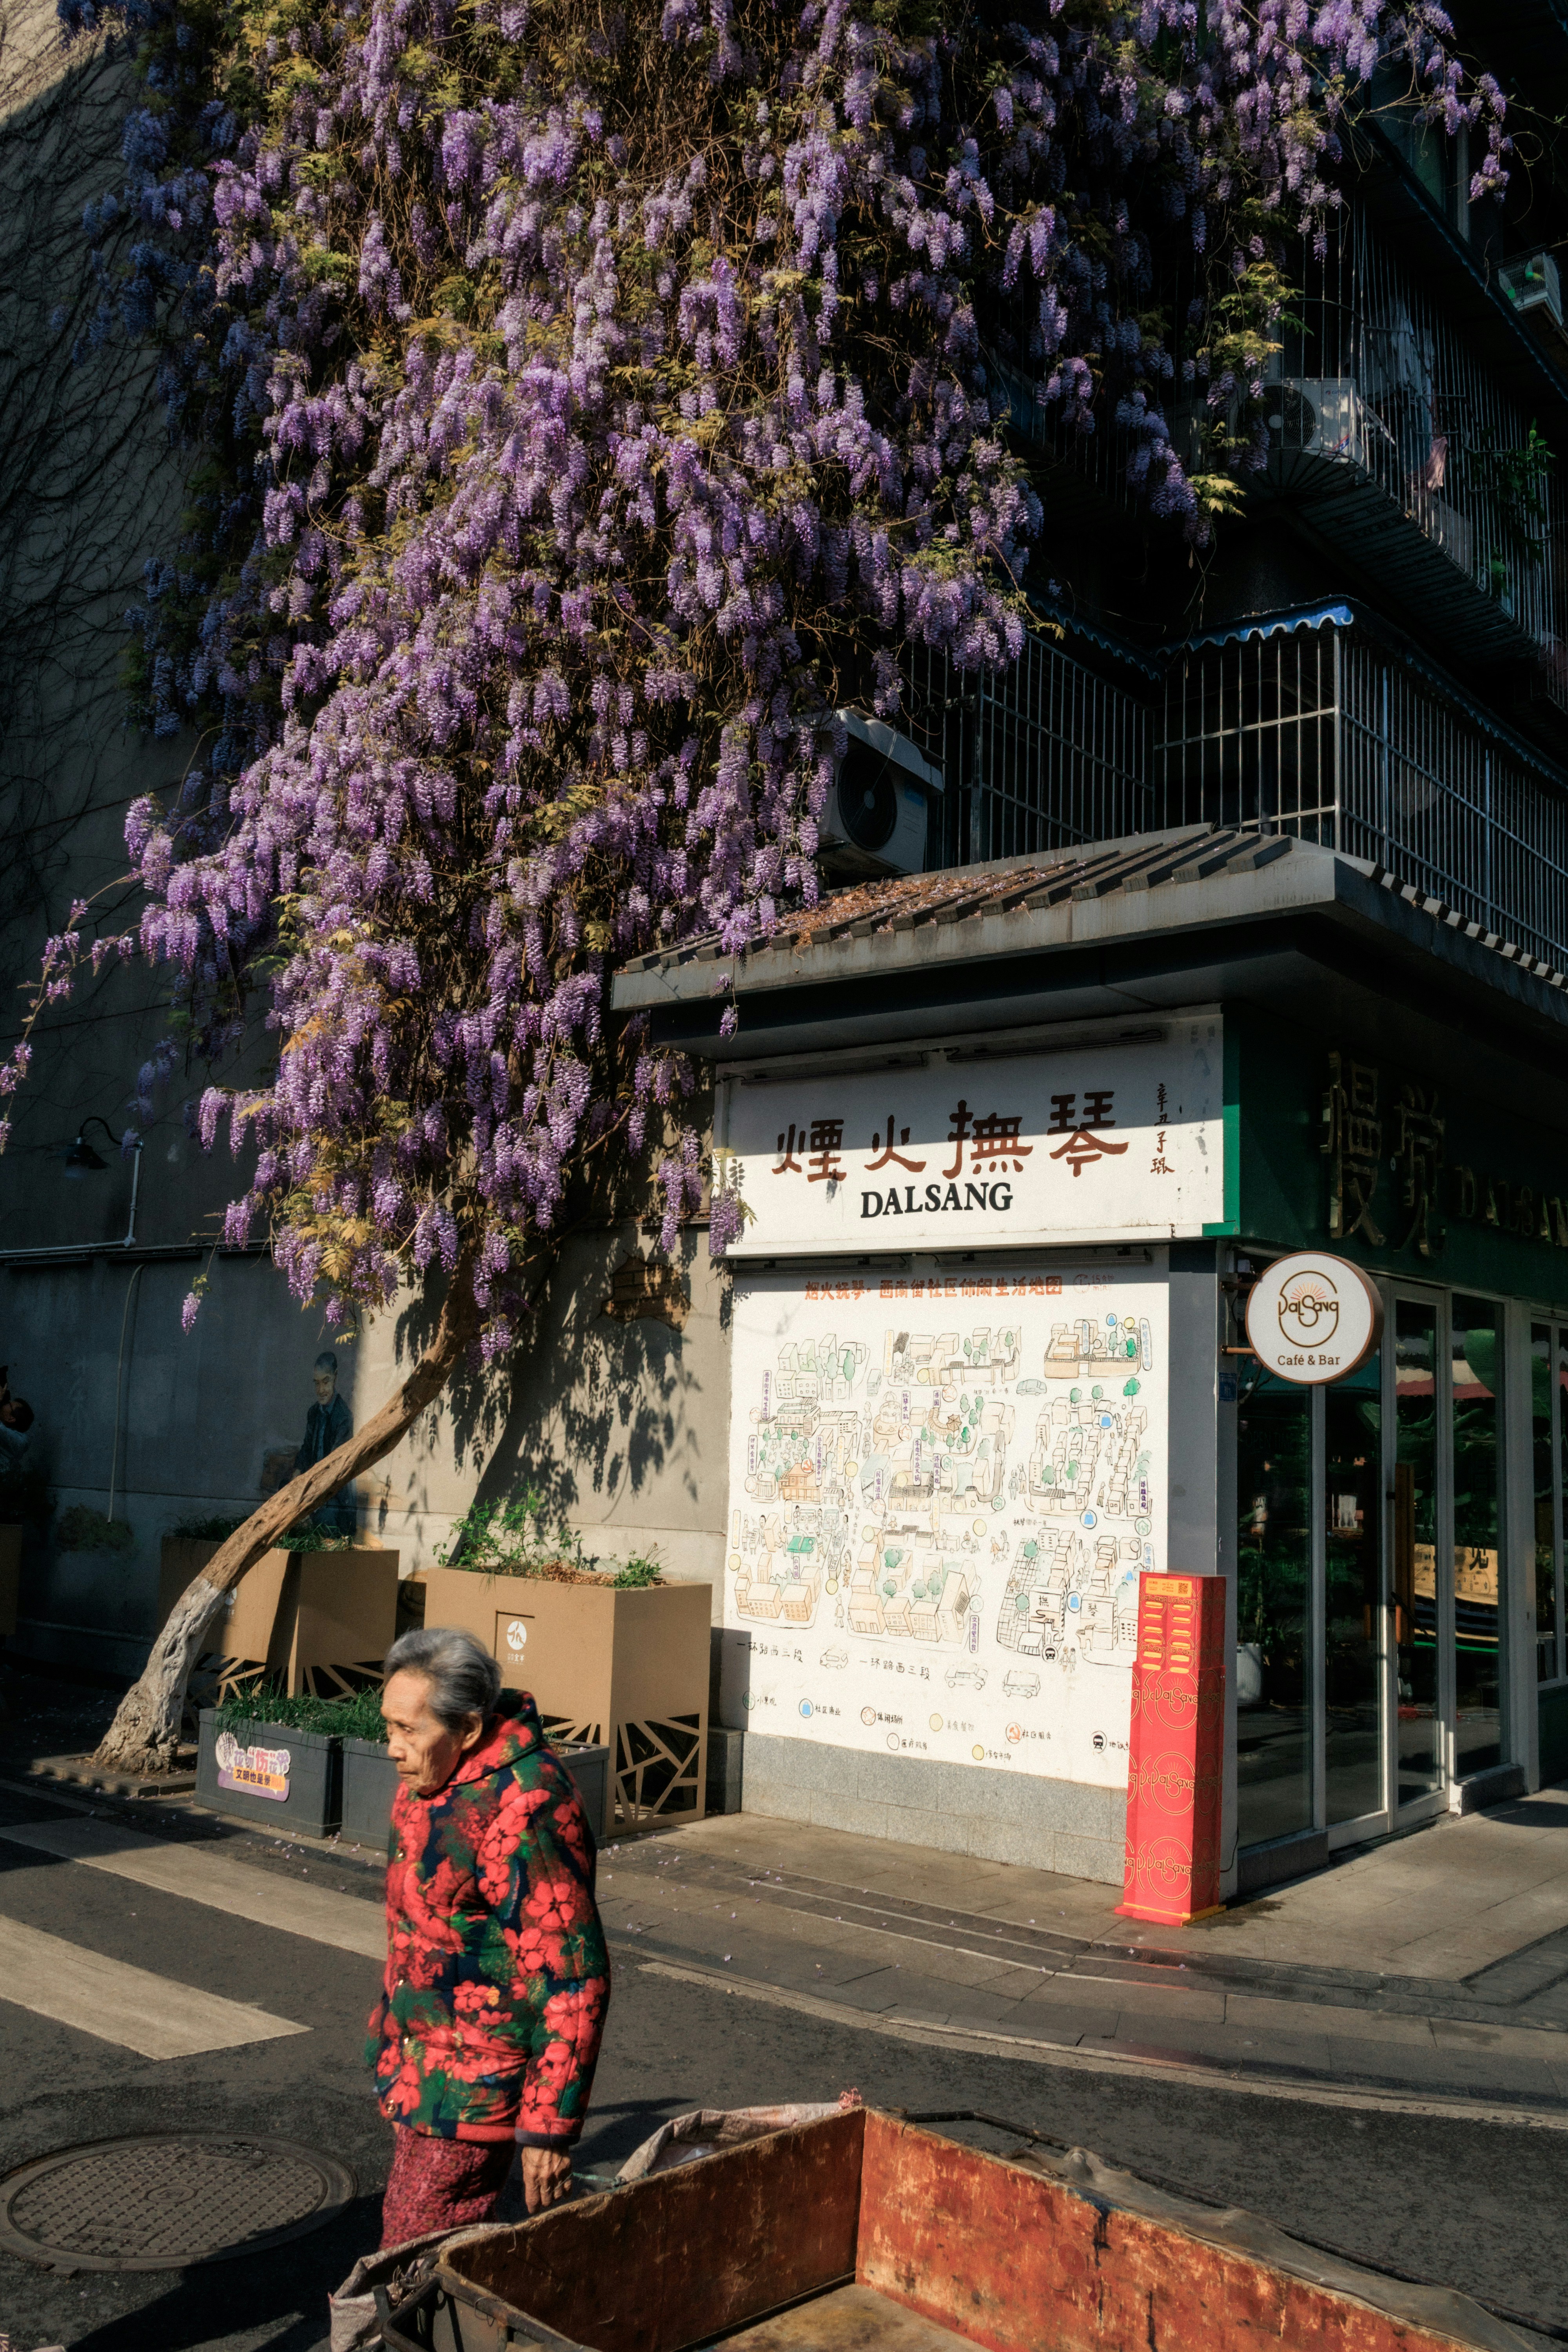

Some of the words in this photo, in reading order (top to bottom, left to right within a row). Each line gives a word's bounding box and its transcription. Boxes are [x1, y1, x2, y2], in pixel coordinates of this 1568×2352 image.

[771, 1091, 1129, 1183] 煙火撫琴
[860, 1182, 1013, 1218] DALSANG
[1278, 1354, 1304, 1365] Café
[1307, 1355, 1316, 1365] &
[1318, 1355, 1341, 1365] Bar
[736, 1642, 803, 1663] 一环路西三段
[859, 1658, 930, 1681] 一环路西三段
